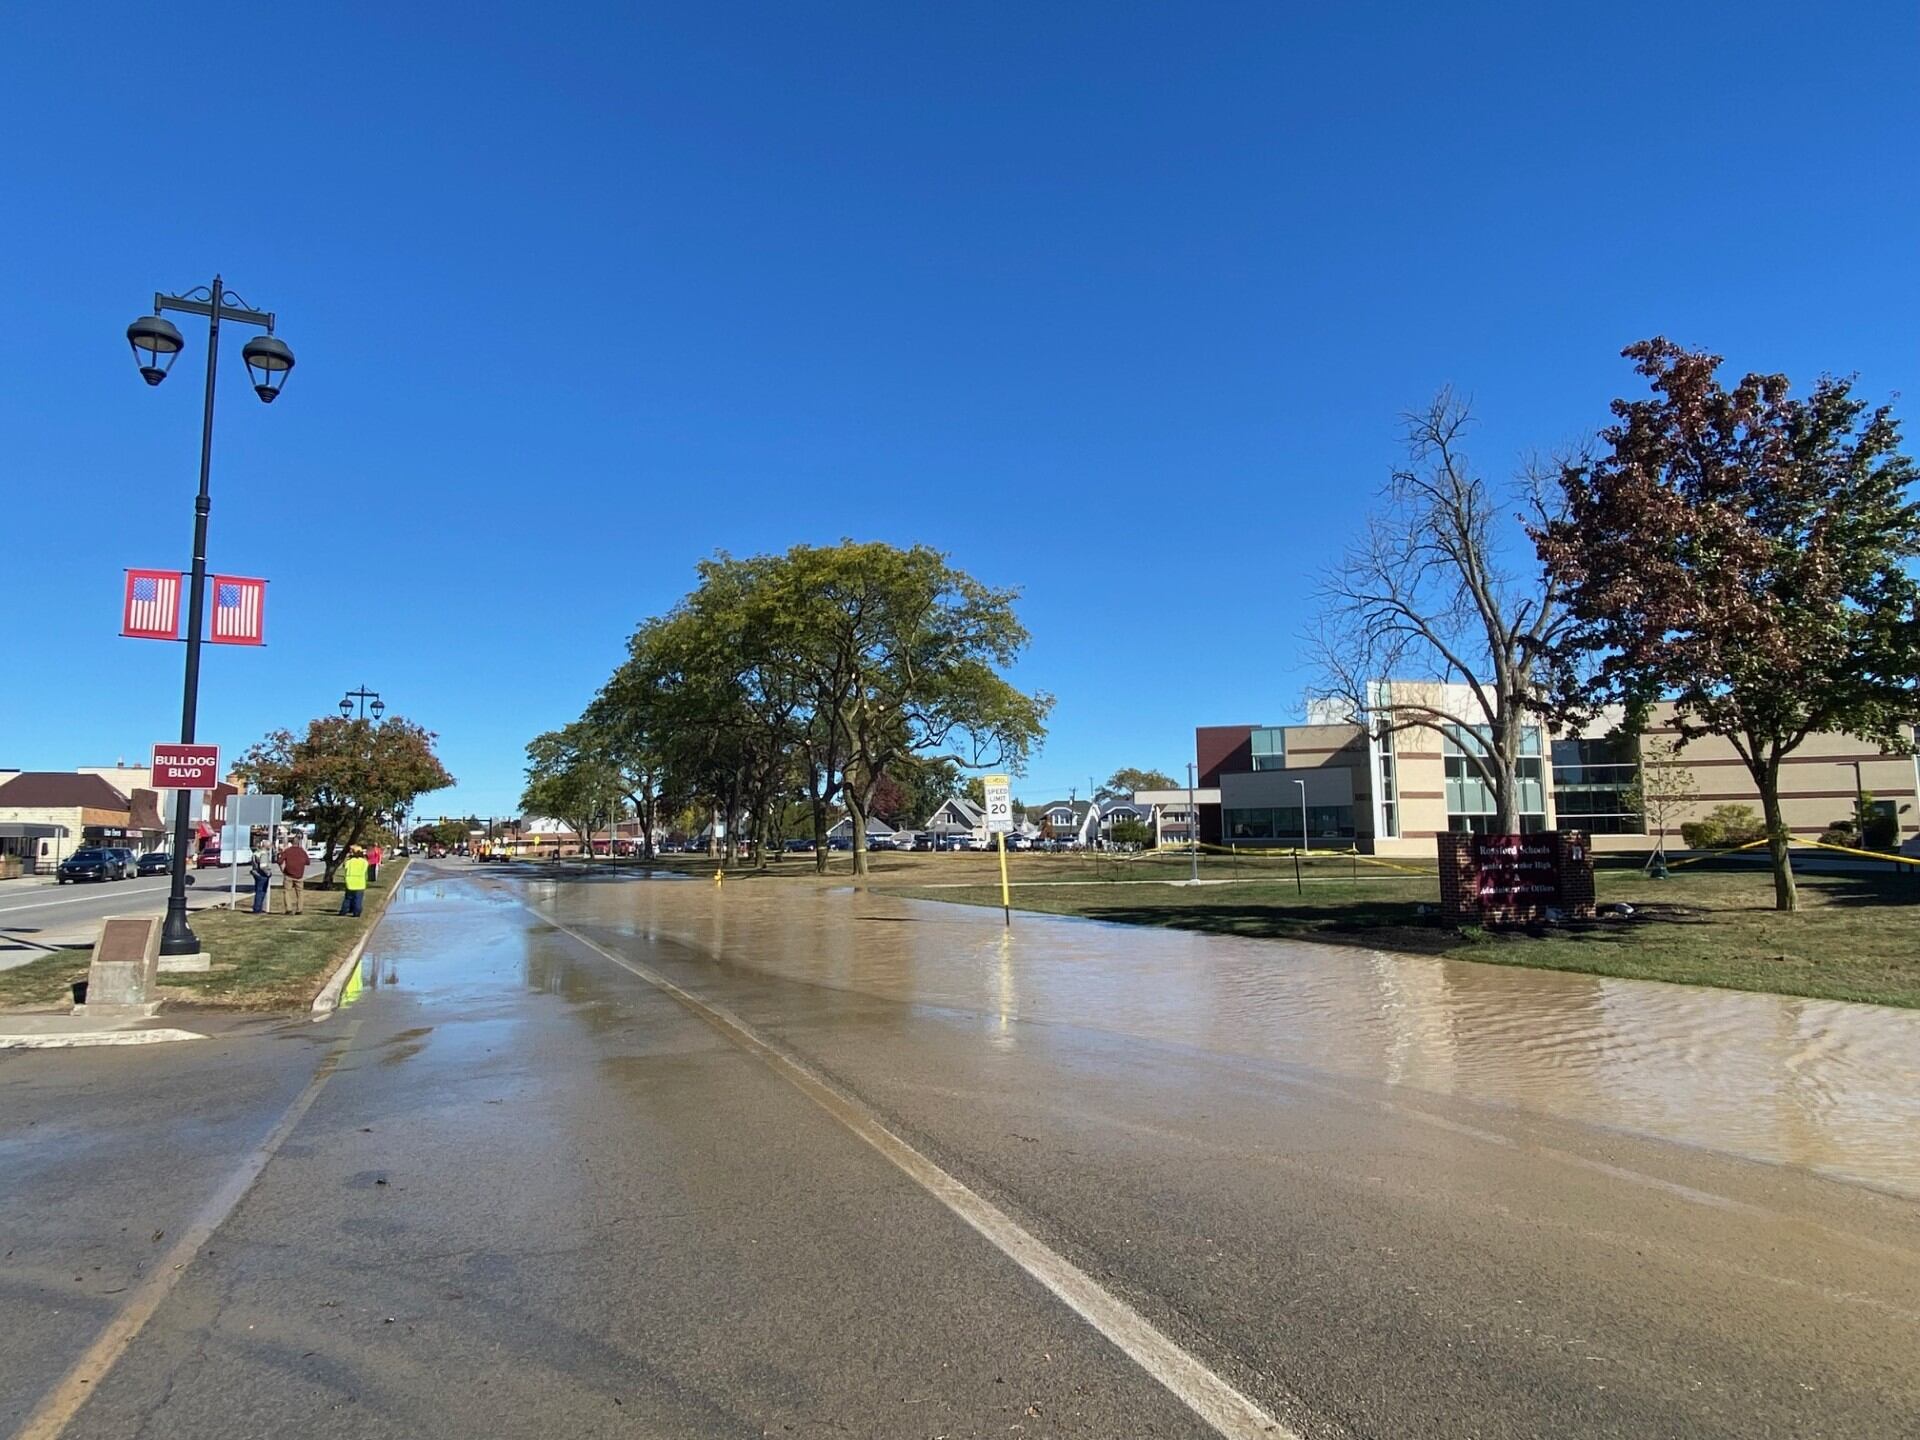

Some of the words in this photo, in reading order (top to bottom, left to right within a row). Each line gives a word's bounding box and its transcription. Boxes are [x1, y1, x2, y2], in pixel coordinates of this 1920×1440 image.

[155, 755, 216, 767] BULLDOG
[167, 767, 202, 778] BLVD
[991, 804, 1007, 814] 20
[1519, 844, 1550, 855] Schools
